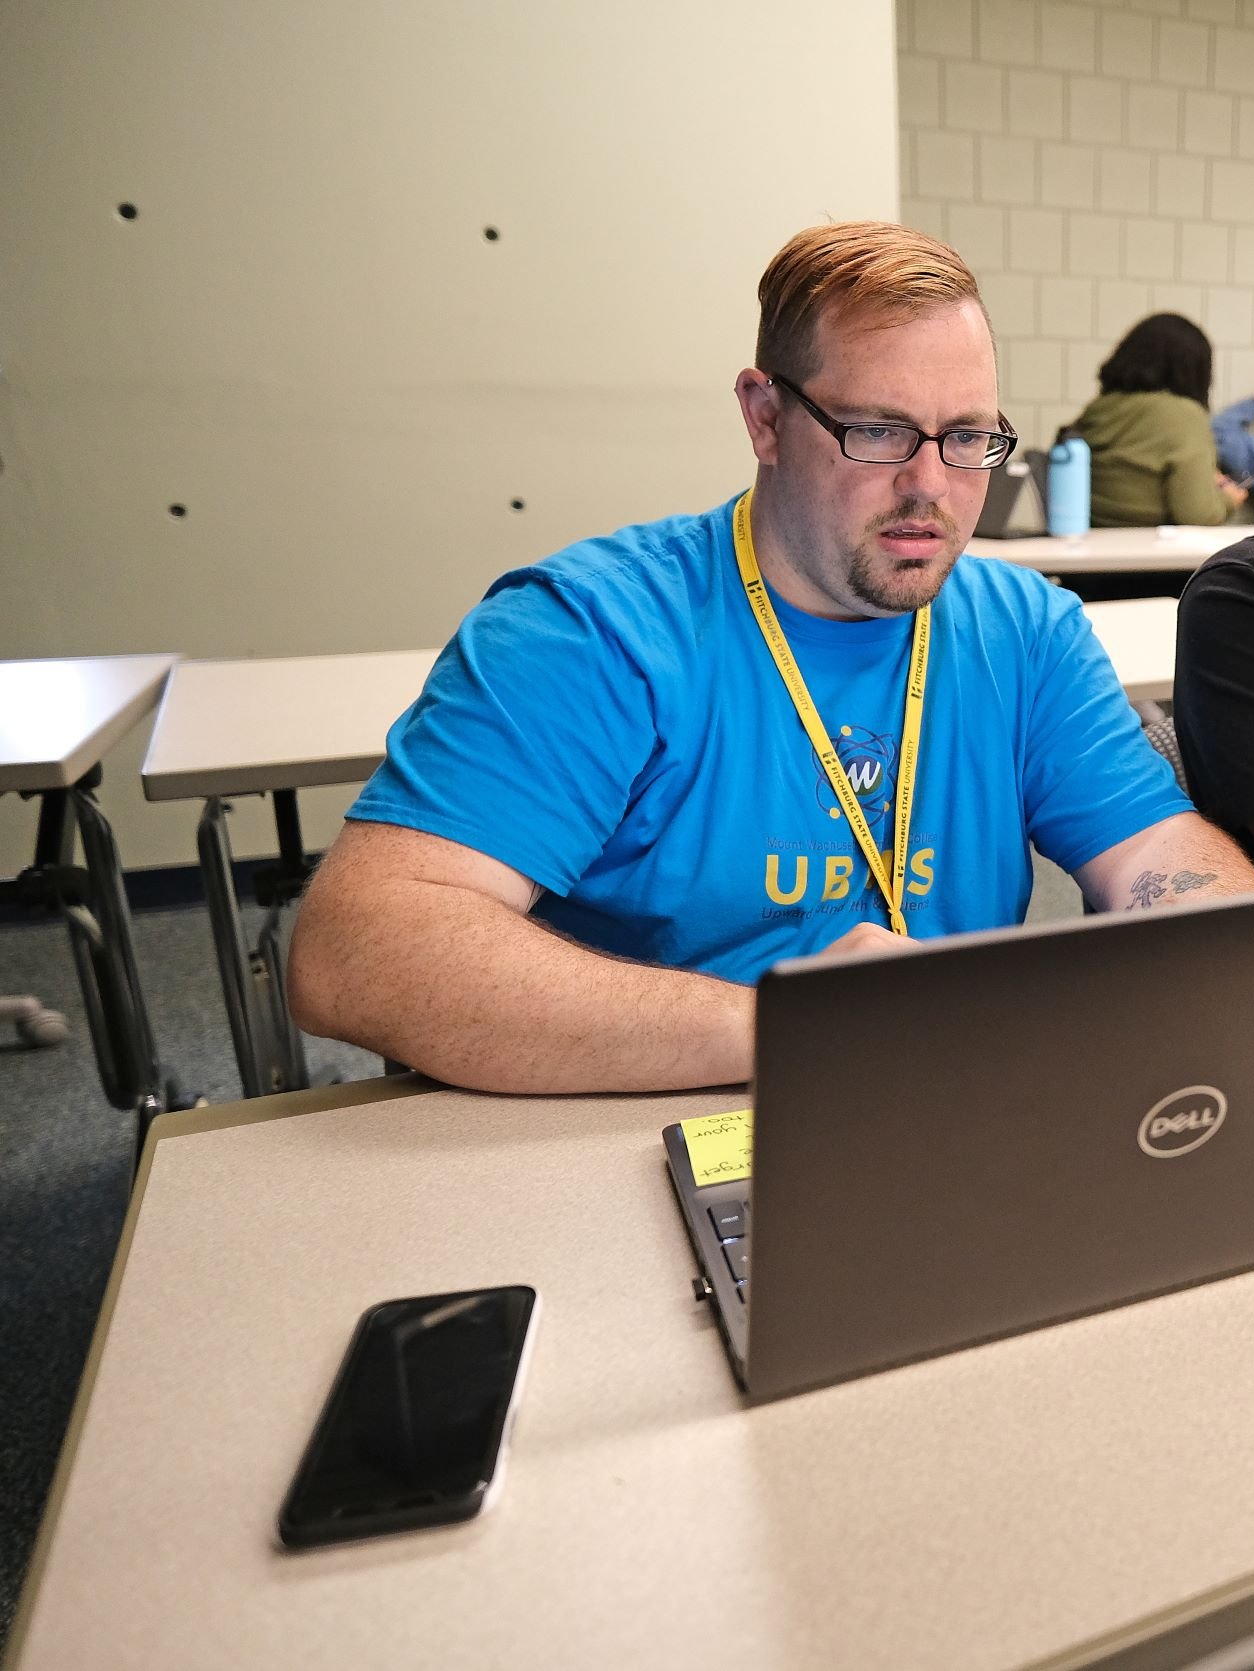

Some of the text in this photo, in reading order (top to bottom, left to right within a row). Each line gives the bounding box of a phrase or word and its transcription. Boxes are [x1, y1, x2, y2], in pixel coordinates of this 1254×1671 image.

[755, 595, 809, 711] FITCHBURG STATE UNIVERSITY
[915, 643, 926, 685] FITCHBURG
[831, 766, 857, 813] FITCHBURG
[853, 814, 867, 838] STATE
[865, 839, 887, 883] UNIVERSITY
[899, 739, 915, 862] FITCHBURG STATE UNIVERSITY
[693, 1123, 737, 1138] your
[1150, 1107, 1215, 1139] DELL
